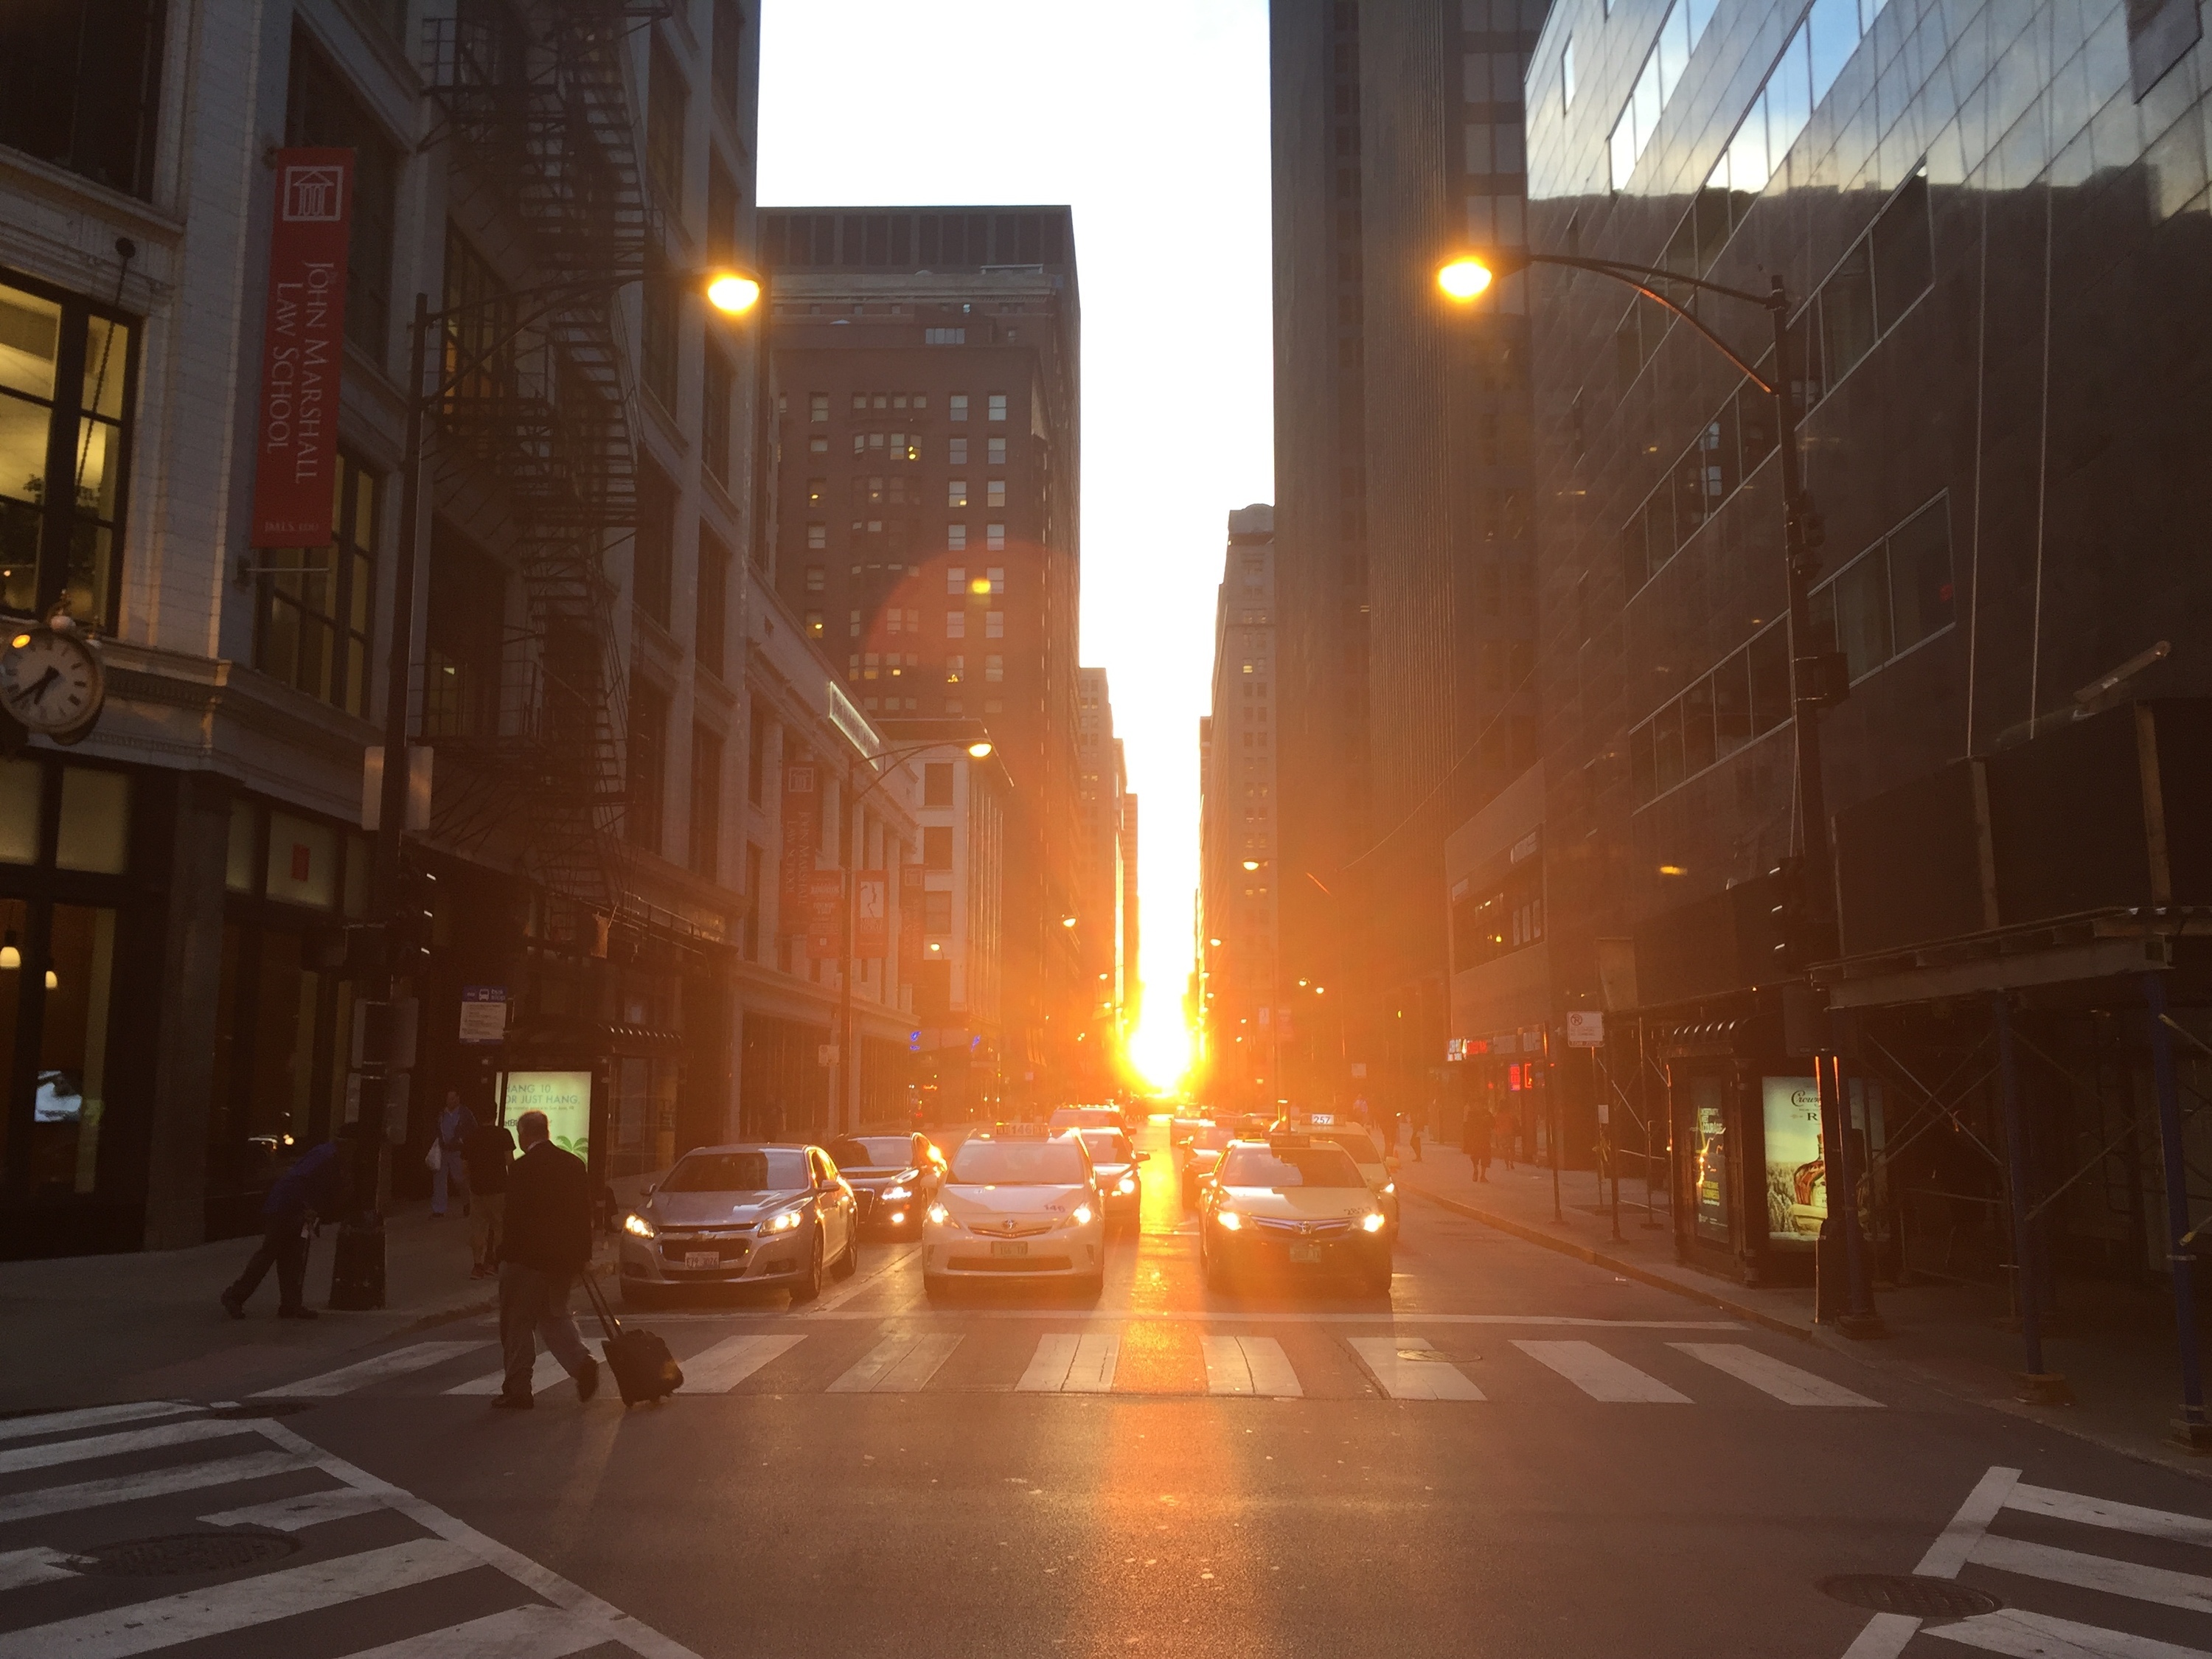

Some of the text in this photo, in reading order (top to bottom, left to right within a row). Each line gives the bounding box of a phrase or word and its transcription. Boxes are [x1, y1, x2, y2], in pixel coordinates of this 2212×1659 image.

[267, 282, 303, 454] LAW SCHOOL
[296, 262, 334, 484] JOHN MARSHALL
[521, 1095, 543, 1104] JUST
[1313, 1116, 1331, 1124] 257
[1011, 1124, 1032, 1135] 146
